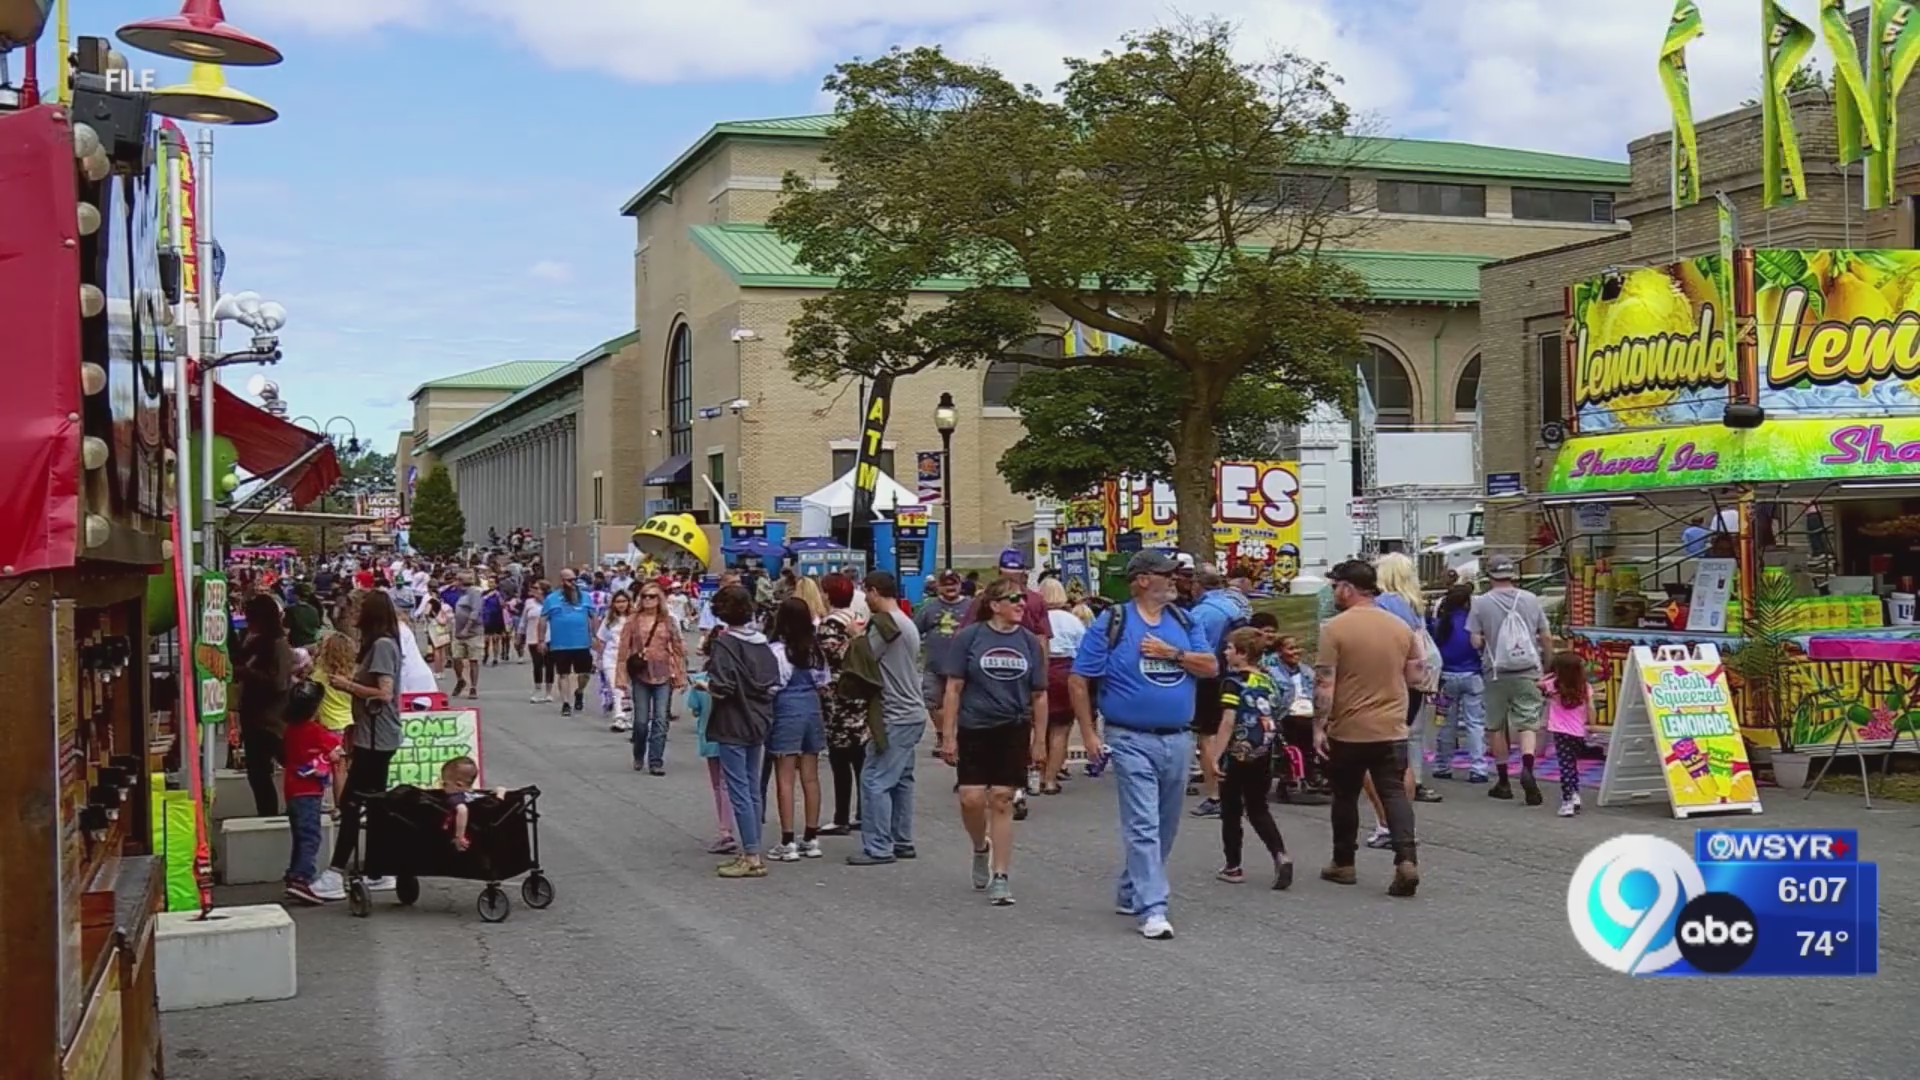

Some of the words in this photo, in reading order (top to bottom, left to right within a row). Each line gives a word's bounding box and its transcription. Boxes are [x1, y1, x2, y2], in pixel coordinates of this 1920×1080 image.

[1577, 304, 1727, 406] Lemonade
[857, 397, 884, 491] ATM
[1569, 444, 1664, 477] Shaved
[1668, 442, 1718, 471] Ice
[1236, 544, 1270, 561] DOGS
[1662, 671, 1707, 690] Fresh
[1653, 685, 1724, 707] Squeezed
[400, 717, 457, 738] OME
[1660, 714, 1733, 738] LEMONADE
